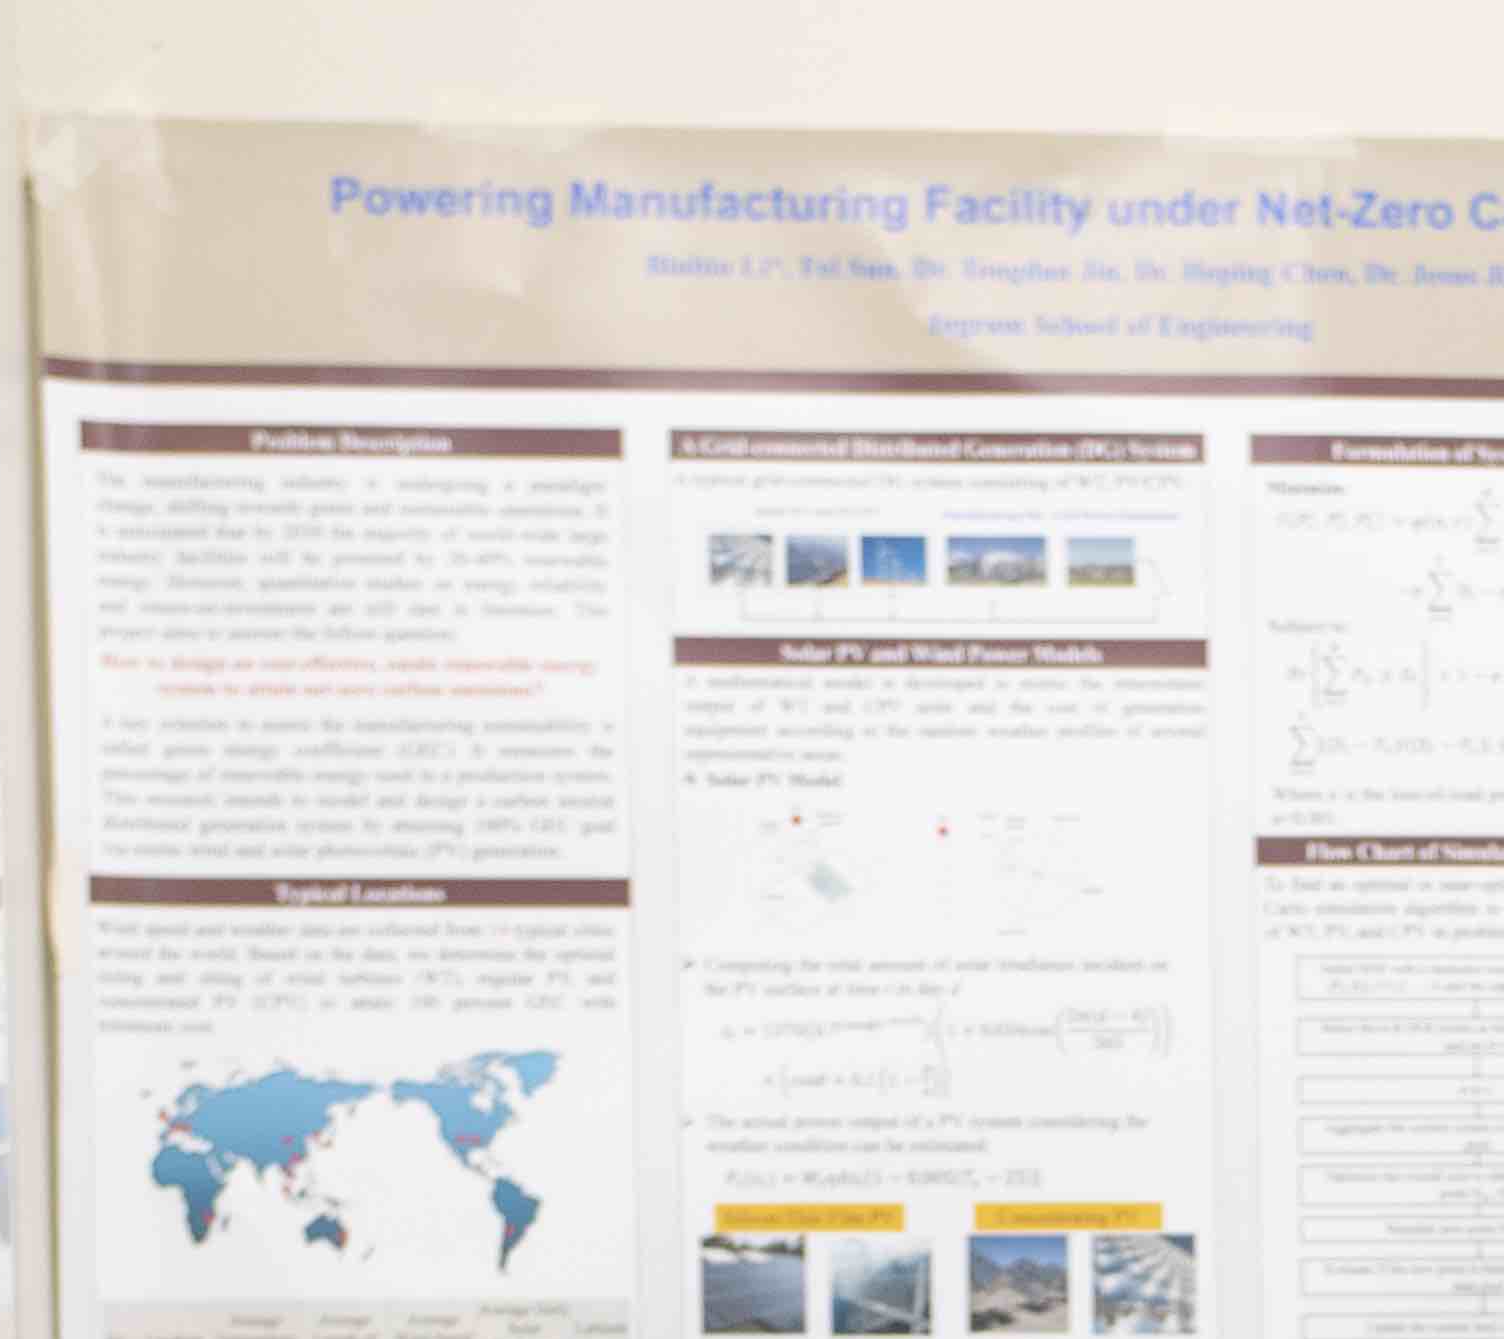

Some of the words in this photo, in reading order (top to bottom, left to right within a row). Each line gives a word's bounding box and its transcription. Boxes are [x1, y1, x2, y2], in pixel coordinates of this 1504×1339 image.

[329, 176, 553, 227] Powering
[568, 180, 909, 232] Manufacturing
[924, 184, 1091, 235] Facility
[1108, 190, 1240, 229] under
[1257, 191, 1454, 231] Net-Zero
[250, 430, 334, 453] Problem
[339, 432, 452, 457] Description
[1332, 441, 1449, 464] Formulation
[1455, 442, 1475, 464] of
[781, 642, 831, 664] Solar
[834, 642, 864, 664] PV
[871, 642, 909, 664] and
[913, 642, 964, 665] Wind
[966, 643, 1027, 665] Power
[1034, 643, 1101, 665] Models
[276, 883, 348, 905] Typical
[352, 883, 446, 904] Locations
